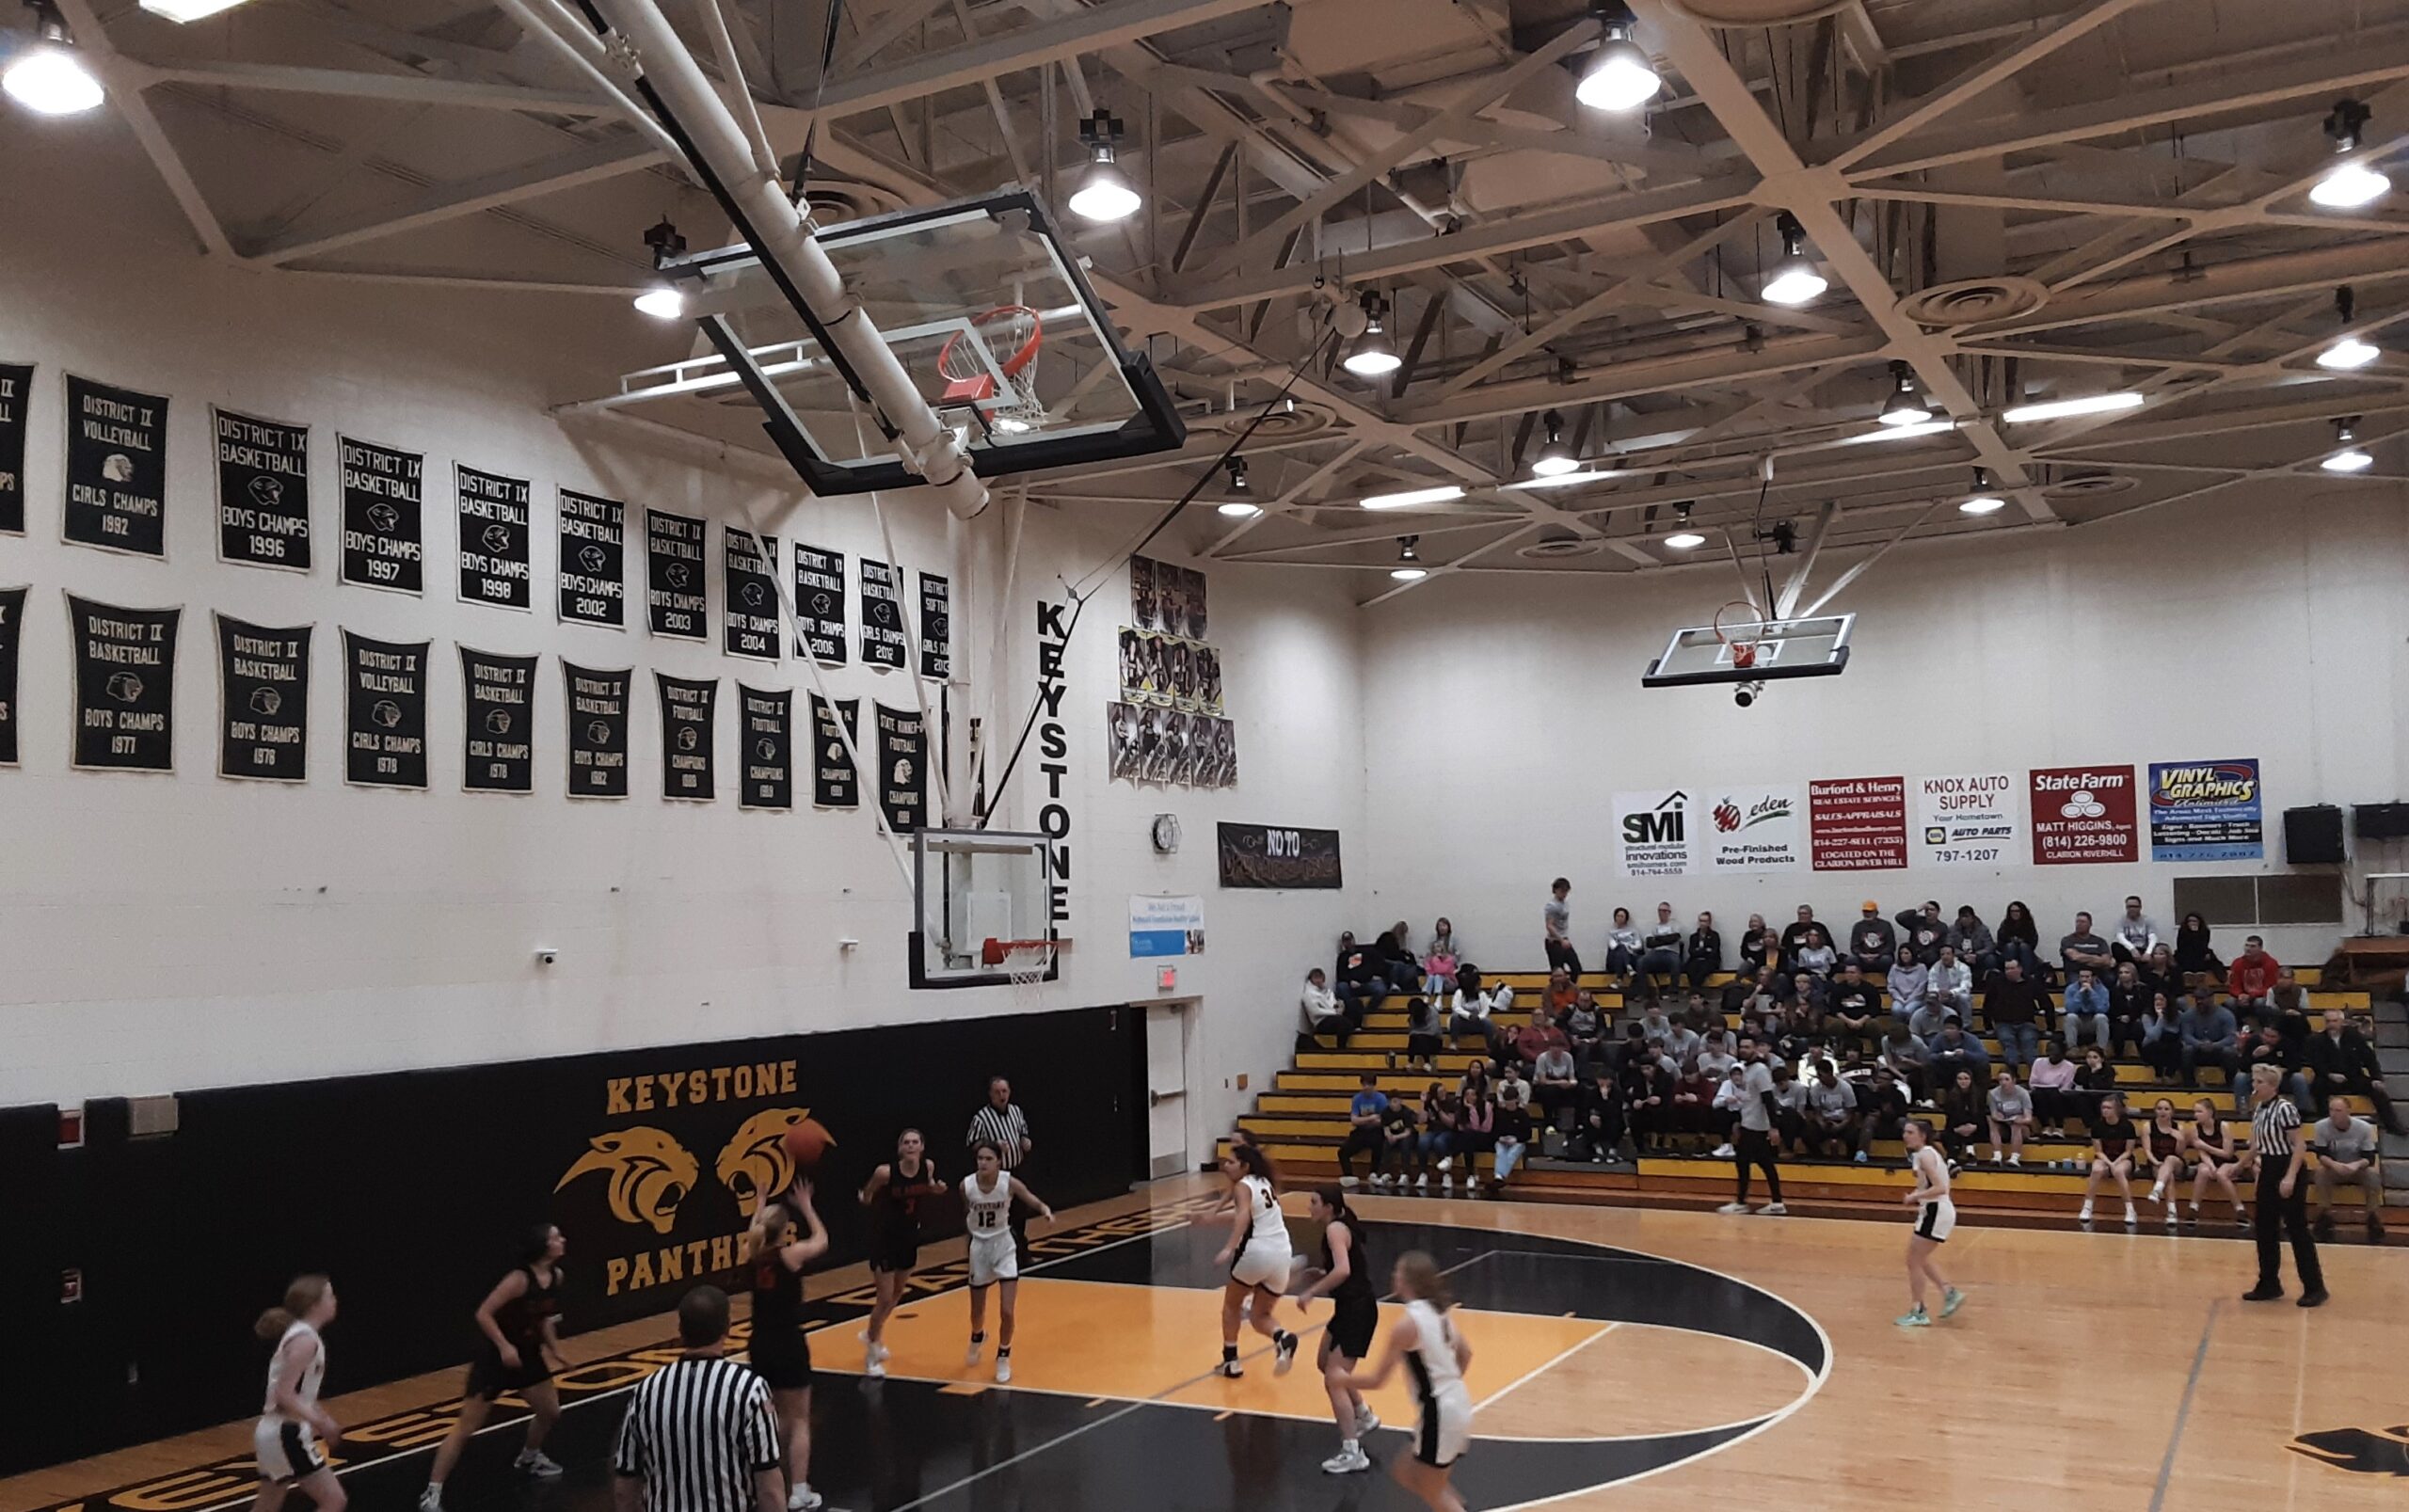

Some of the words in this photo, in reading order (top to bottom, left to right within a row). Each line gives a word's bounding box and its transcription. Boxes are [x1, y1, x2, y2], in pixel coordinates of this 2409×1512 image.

[84, 395, 135, 420] DISTRICT
[140, 409, 152, 426] IX
[84, 423, 152, 451] VOLLEYBALL
[218, 417, 284, 448] DISTRICT
[291, 434, 306, 453] IX
[221, 444, 306, 477] BASKETBALL
[344, 445, 402, 474] DISTRICT
[407, 460, 421, 478] IX
[345, 470, 420, 502] BASKETBALL
[460, 472, 511, 499] DISTRICT
[516, 485, 527, 503] IX
[72, 484, 105, 507] GIRLS
[114, 494, 157, 517] CHAMPS
[460, 496, 527, 525] BASKETBALL
[561, 495, 607, 520] DISTRICT
[612, 507, 623, 524] IX
[223, 505, 256, 529] BOYS
[259, 512, 308, 538] CHAMPS
[561, 517, 622, 545] BASKETBALL
[651, 516, 687, 537] DISTRICT
[693, 525, 701, 540] IX
[249, 534, 284, 558] 1996
[346, 531, 375, 553] BOYS
[378, 537, 421, 562] CHAMPS
[651, 537, 702, 561] BASKETBALL
[769, 543, 775, 557] IX
[367, 559, 400, 581] 1997
[461, 551, 487, 572] BOYS
[491, 557, 529, 580] CHAMPS
[728, 553, 767, 575] BASKETBA
[797, 549, 826, 570] DISTRICT
[481, 579, 511, 598] 1998
[561, 572, 585, 592] BOYS
[587, 578, 623, 598] CHAMPS
[798, 569, 841, 592] BASKETBALL
[576, 597, 607, 617] 2002
[651, 589, 672, 607] BOYS
[674, 594, 705, 612] CHAMPS
[88, 615, 143, 640] DISTRICT
[151, 624, 164, 642] IX
[665, 613, 691, 630] 2003
[727, 612, 746, 629] BOYS
[750, 616, 777, 634] CHAMPS
[821, 620, 845, 638] CHAMPS
[234, 634, 280, 658] DISTRICT
[288, 641, 298, 658] IX
[741, 634, 766, 651] 2004
[863, 625, 880, 640] GIRLS
[883, 629, 904, 645] CHAMPS
[89, 640, 161, 665] BASKETBALL
[811, 639, 834, 655] 2006
[234, 657, 296, 681] BASKETBALL
[359, 648, 401, 671] DISTRICT
[406, 656, 416, 672] IX
[359, 671, 415, 694] VOLLEYBALL
[474, 663, 512, 682] DISTRICT
[517, 669, 525, 684] IX
[475, 684, 524, 704] BASKETBALL
[575, 676, 610, 695] DISTRICT
[576, 696, 620, 714] BASKETBALL
[86, 708, 113, 729] BOYS
[119, 712, 164, 732] CHAMPS
[231, 721, 256, 740] BOYS
[261, 724, 299, 743] CHAMPS
[353, 732, 380, 750] GIRLS
[385, 735, 421, 754] CHAMPS
[112, 737, 136, 755] 1977
[471, 740, 492, 756] GIRLS
[496, 743, 529, 760] CHAMPS
[889, 737, 917, 753] FOOTBALL
[596, 753, 623, 767] CHAMPS
[1037, 600, 1071, 920] KEYSTONE
[1811, 783, 1854, 795] Burford
[1856, 783, 1866, 793] &
[1868, 782, 1902, 795] Henry
[1924, 779, 1965, 794] KNOX
[1969, 776, 2009, 791] AUTO
[2162, 768, 2214, 789] VINYL
[1939, 794, 1995, 810] SUPPLY
[2170, 781, 2254, 801] GRAPHICS
[1747, 795, 1794, 819] eden
[2036, 822, 2065, 832] MATT
[1267, 829, 1284, 856] NO
[1284, 831, 1300, 857] TO
[1722, 844, 1788, 853] Pre-Finished
[2042, 836, 2071, 850] (814)
[2074, 835, 2127, 846] 226-9800
[1626, 851, 1687, 861] innovations
[1747, 855, 1795, 864] Products
[1936, 849, 1999, 862] 797-1207
[607, 1059, 797, 1115] KEYSTONE
[979, 1211, 996, 1227] 12
